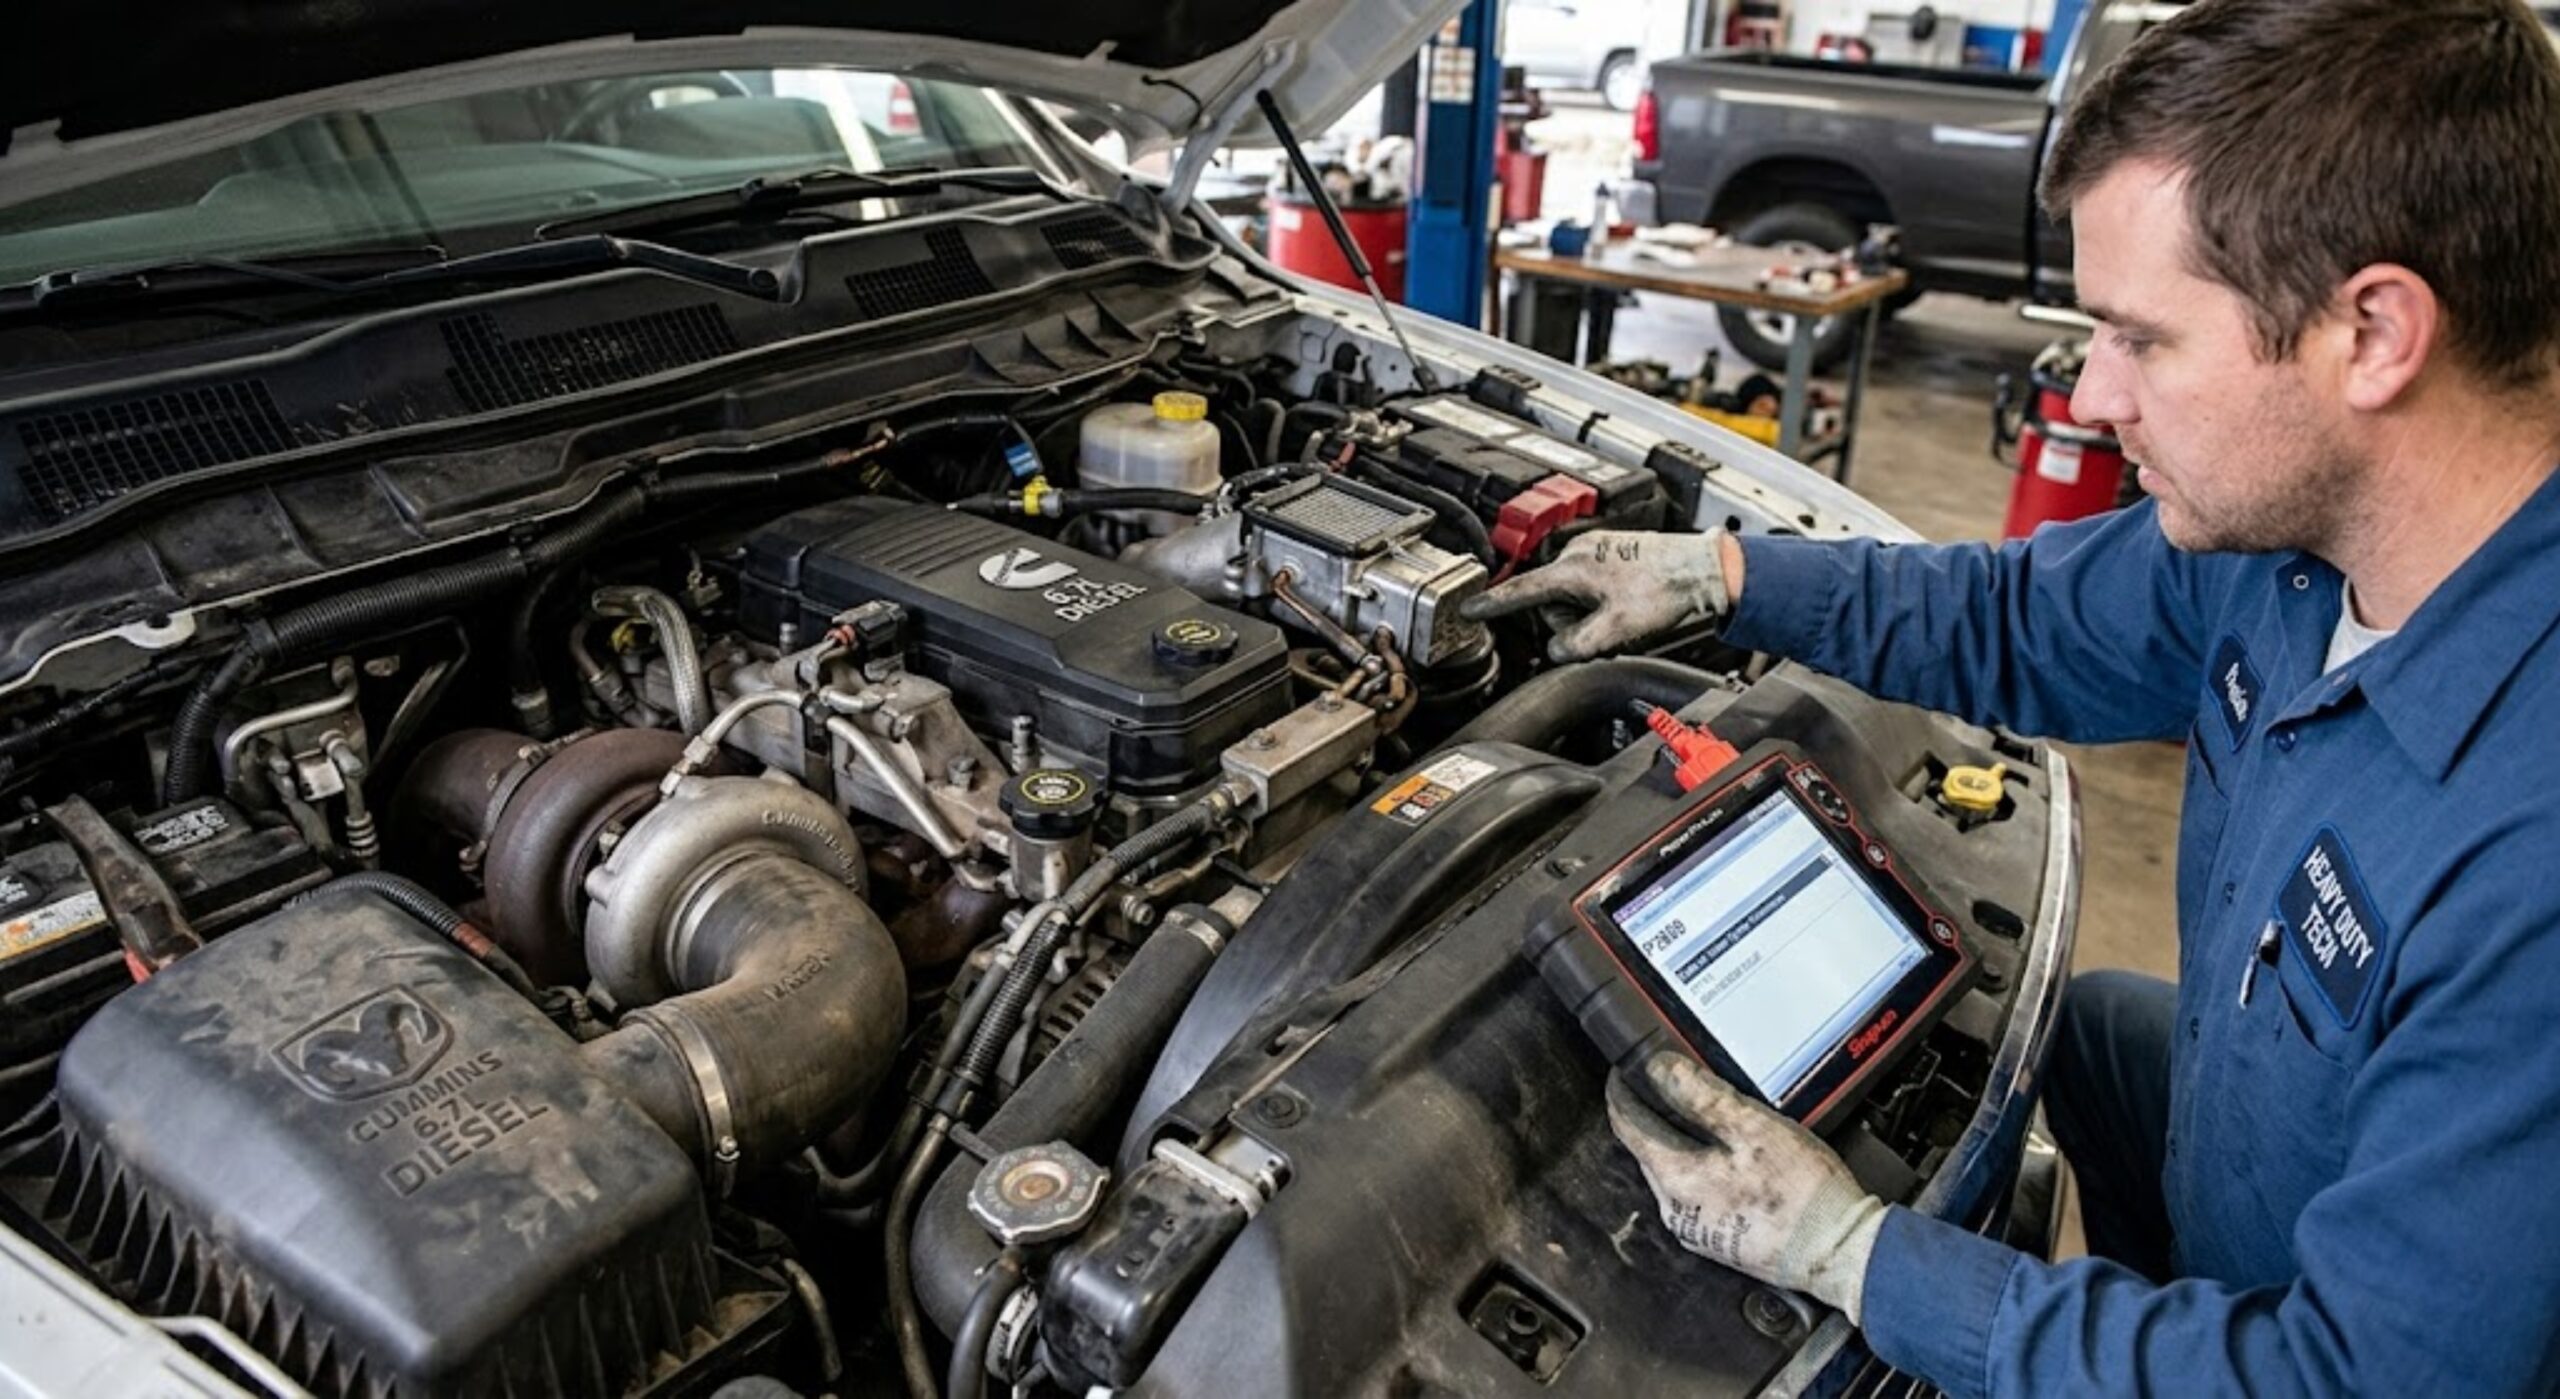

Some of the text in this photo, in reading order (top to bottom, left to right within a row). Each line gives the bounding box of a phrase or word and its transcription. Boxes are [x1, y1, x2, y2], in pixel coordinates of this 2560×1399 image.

[2303, 845, 2374, 970] HEAVY DUTY
[352, 1050, 503, 1143] CUMMINS
[413, 1091, 488, 1138] 6.7L
[383, 1095, 549, 1196] DIESEL
